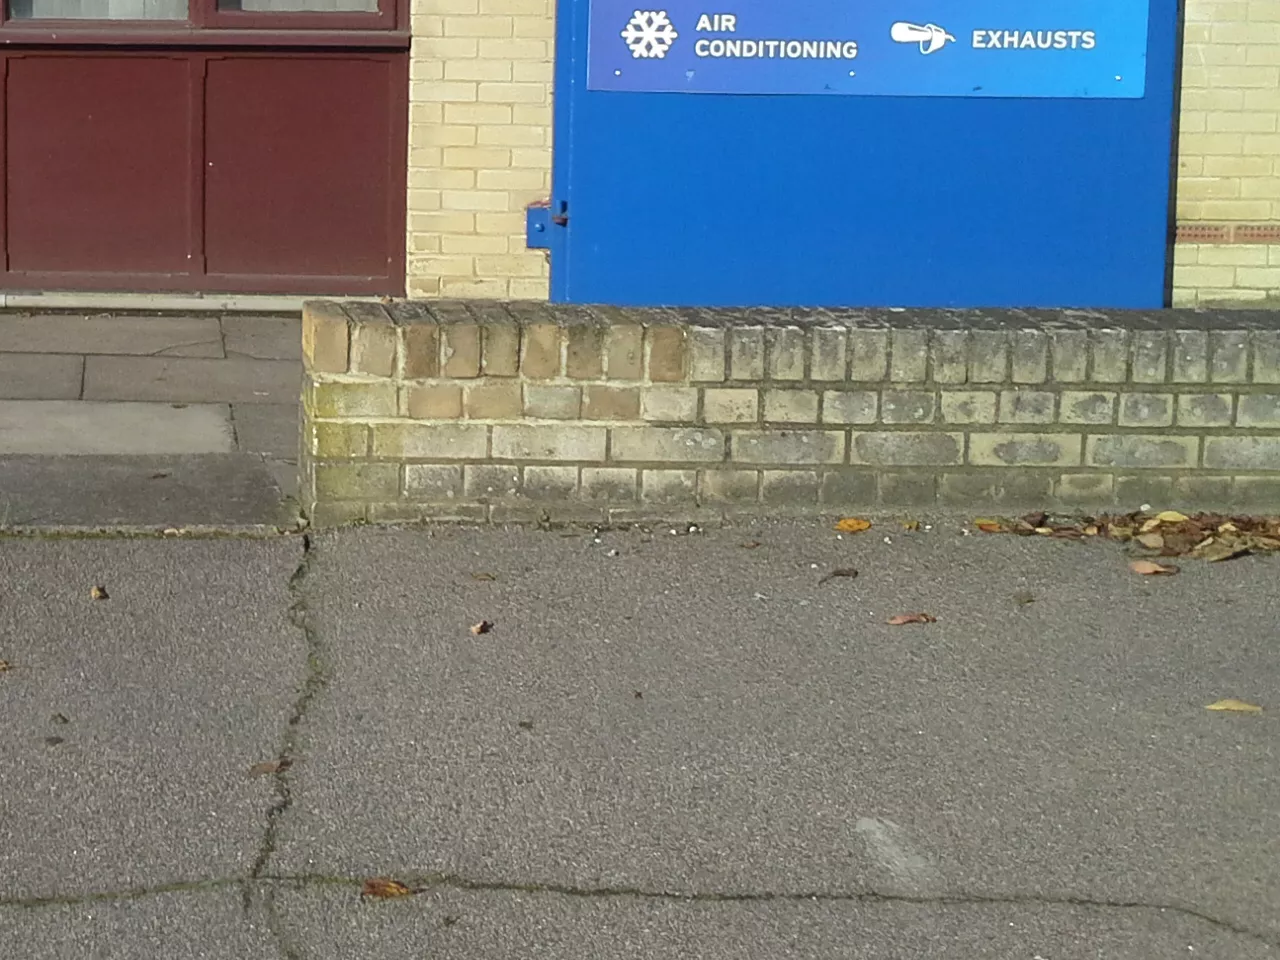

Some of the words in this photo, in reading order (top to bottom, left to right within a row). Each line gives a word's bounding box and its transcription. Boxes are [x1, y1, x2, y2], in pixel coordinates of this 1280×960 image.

[695, 14, 736, 32] AIR
[694, 39, 858, 60] CONDITIONING
[971, 29, 1096, 50] EXHAUSTS
